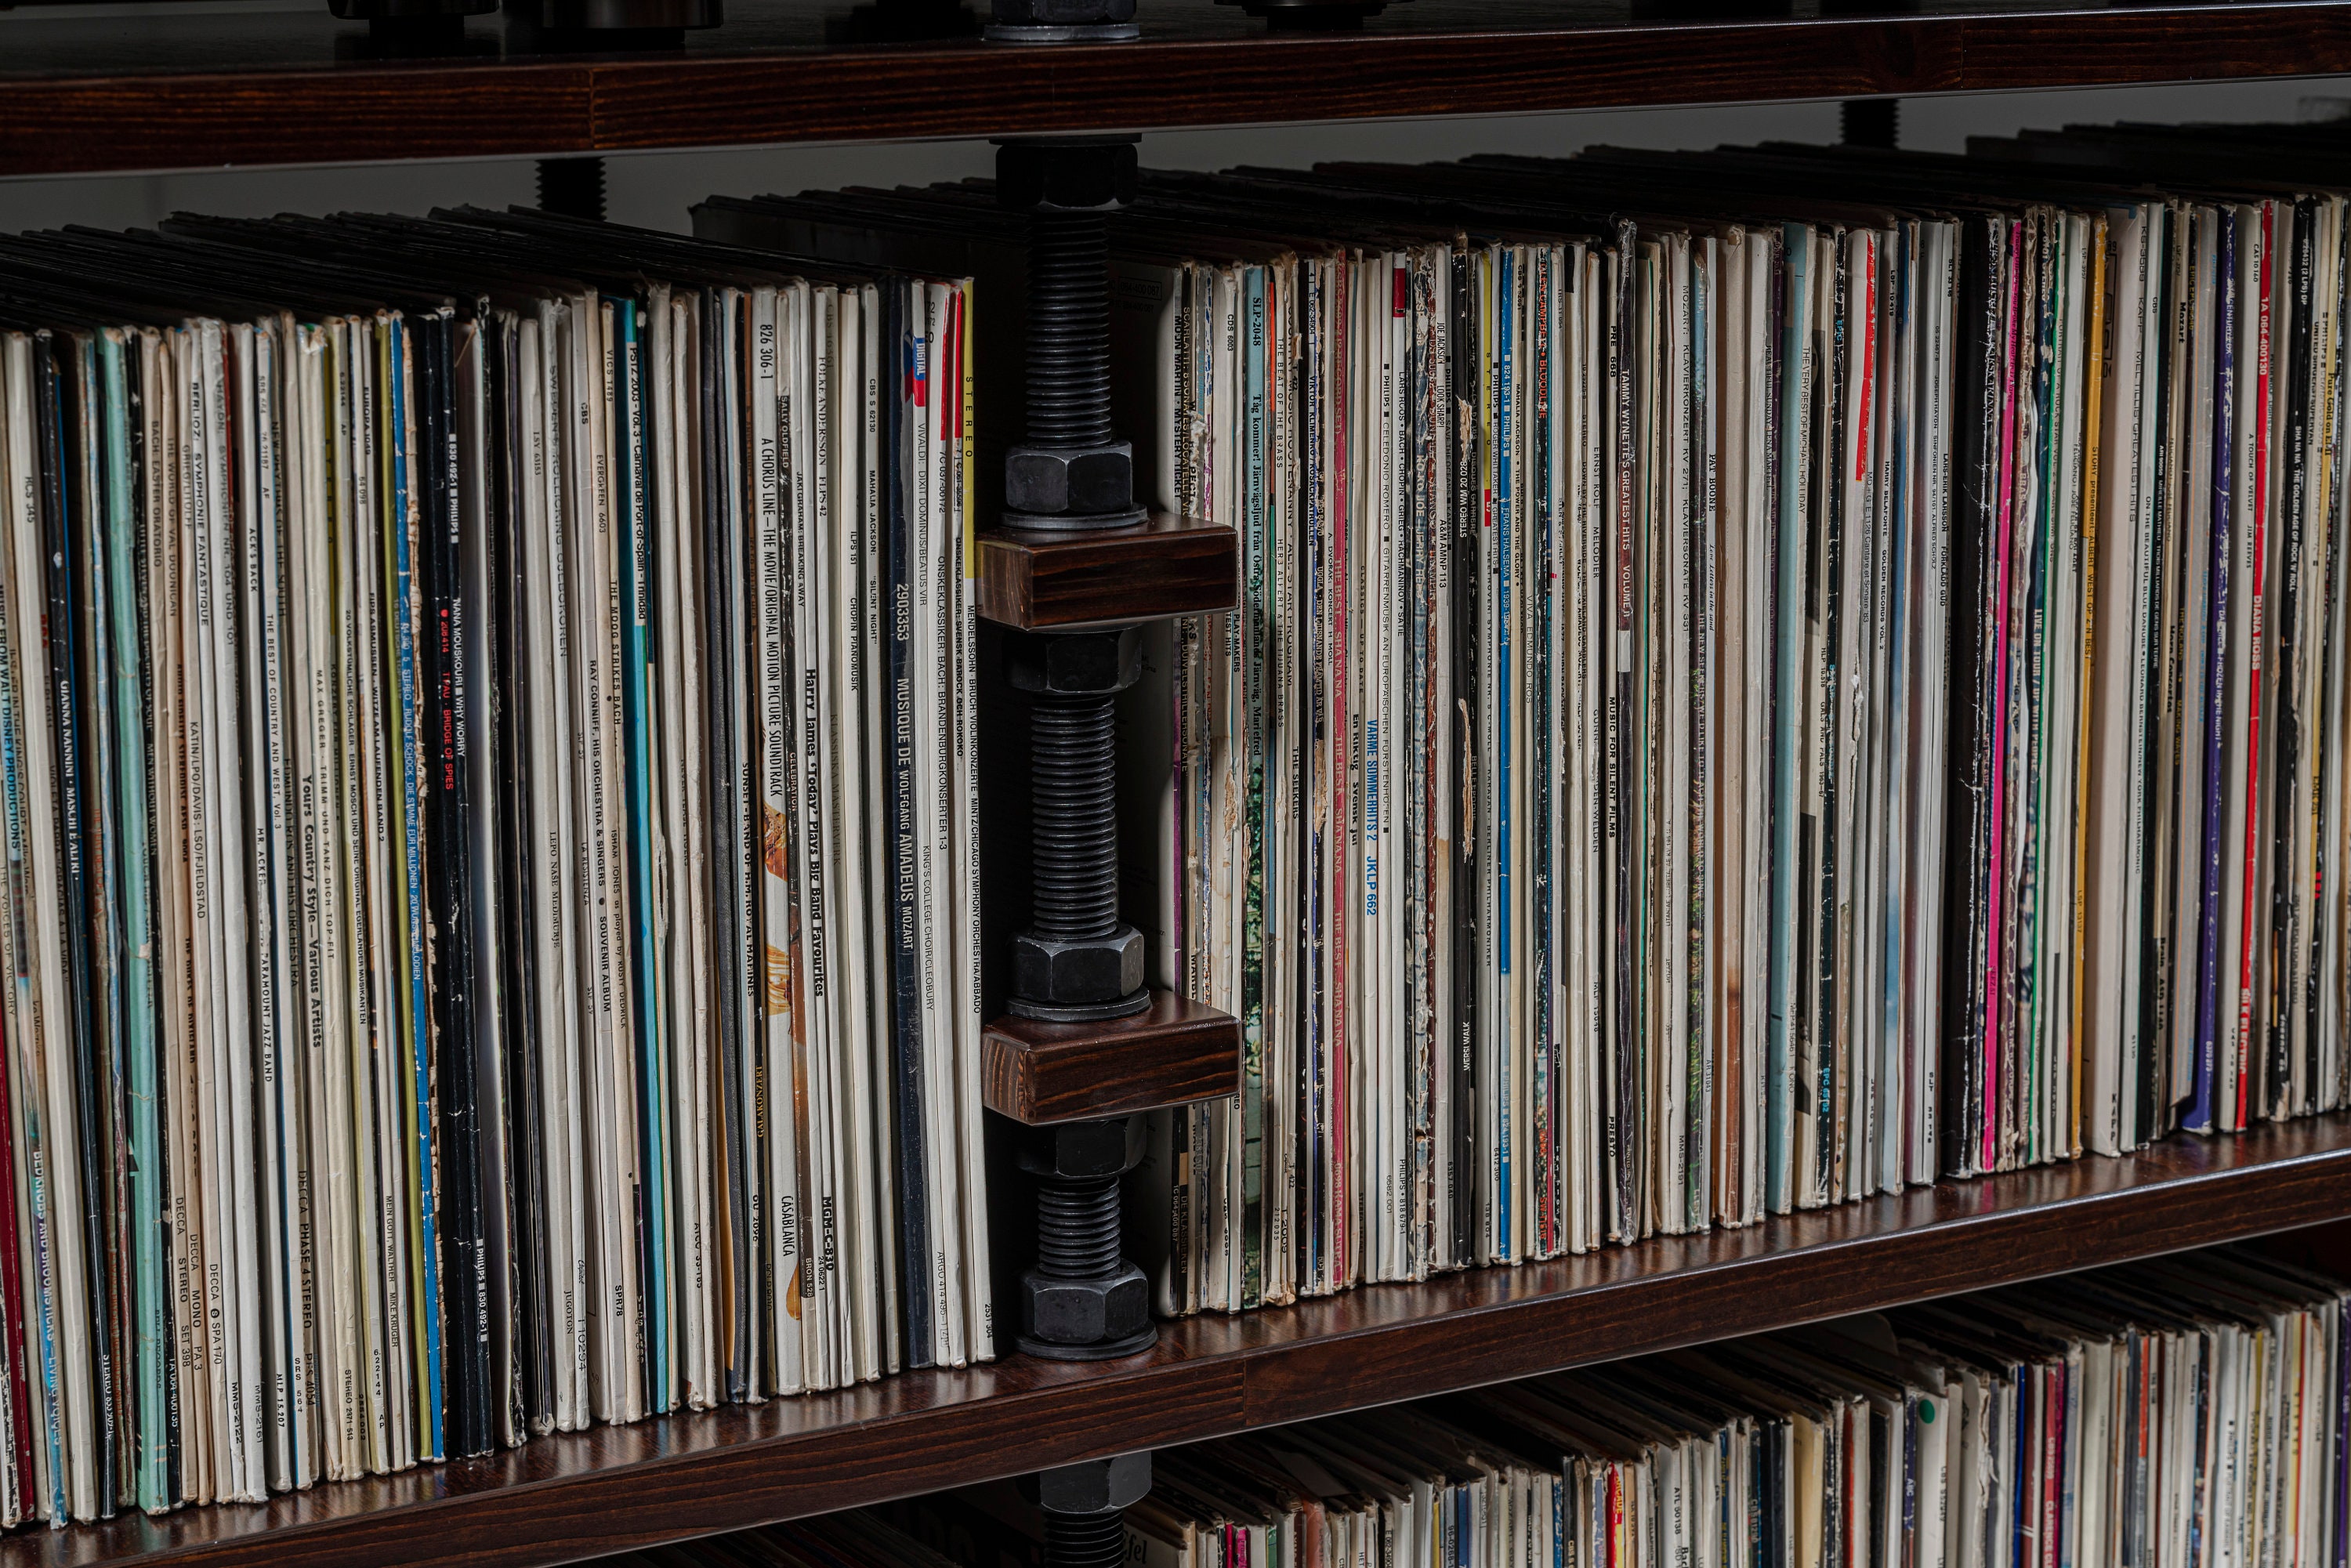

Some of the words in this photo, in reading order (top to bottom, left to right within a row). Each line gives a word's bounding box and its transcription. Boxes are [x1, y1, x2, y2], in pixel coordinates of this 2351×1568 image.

[1252, 298, 1261, 346] SLP-2048
[2260, 297, 2268, 312] 1A
[759, 324, 773, 344] 826
[1436, 322, 1445, 335] JOE
[760, 349, 774, 379] 306-1
[915, 343, 926, 375] DIGITAL
[1436, 338, 1445, 364] JACKSON
[1621, 369, 1630, 407] TAMMY
[2324, 372, 2335, 394] Pure
[781, 397, 789, 422] SALLY
[1251, 395, 1261, 415] Tåg
[918, 423, 926, 465] VIVALDI:
[1252, 418, 1261, 462] kommer!
[1621, 409, 1630, 468] WYNETTE'S
[2325, 422, 2331, 433] on
[449, 444, 458, 459] 830
[781, 425, 790, 468] OLDFIELD
[2295, 442, 2301, 451] NA
[2295, 454, 2301, 463] NA
[449, 462, 458, 487] 492-1
[762, 448, 777, 490] CHORUS
[1251, 465, 1262, 527] Järnvägsljud
[1252, 530, 1262, 552] från
[1252, 556, 1262, 581] Östra
[452, 599, 461, 625] NANA
[896, 584, 909, 641] 2903353
[919, 589, 928, 606] VIR
[2252, 595, 2262, 629] DIANA
[1252, 585, 1262, 658] Södermanlands
[454, 628, 463, 686] MOUSKOURI
[766, 642, 780, 682] MOTION
[937, 656, 946, 687] BACH:
[2251, 636, 2261, 670] ROSS
[805, 669, 816, 710] Harry
[1251, 661, 1262, 702] Järnväg,
[768, 686, 781, 727] PICTURE
[897, 679, 911, 744] MUSIQUE
[3, 708, 13, 753] DISNEY
[444, 709, 452, 746] BRIDGE
[806, 717, 817, 756] James
[1253, 707, 1262, 756] Mariefred
[770, 731, 783, 796] SOUNDTRACK
[897, 748, 911, 766] DE
[938, 691, 947, 832] BRANDENBURGKONSERTER
[445, 763, 454, 789] SPIES
[789, 752, 798, 812] CELEBRATION
[302, 775, 313, 817] Yours
[898, 770, 911, 829] WOLFGANG
[1367, 760, 1378, 830] SOMMERHITS
[303, 825, 317, 882] Country
[807, 820, 820, 856] Plays
[194, 829, 205, 918] LSO/FJELDSTAD
[809, 860, 820, 882] Big
[900, 834, 913, 902] AMADEUS
[1367, 856, 1376, 890] JKLP
[810, 887, 821, 920] Band
[1367, 894, 1376, 915] 662
[596, 841, 605, 886] SINGERS
[602, 975, 610, 1012] ALBUM
[902, 907, 913, 950] MOZART
[812, 927, 825, 997] Favourites
[311, 998, 323, 1048] Artists
[176, 1197, 184, 1234] DECCA
[1180, 1196, 1187, 1208] DE
[781, 1196, 795, 1256] CASABLANCA
[822, 1196, 835, 1271] MGM-C-830
[190, 1234, 199, 1270] DECCA
[179, 1258, 188, 1302] STEREO
[210, 1264, 219, 1300] DECCA
[192, 1291, 201, 1328] MONO
[181, 1325, 190, 1343] SET
[212, 1323, 220, 1344] SPA
[182, 1348, 190, 1367] 398
[194, 1346, 202, 1360] PA
[212, 1347, 222, 1364] 170
